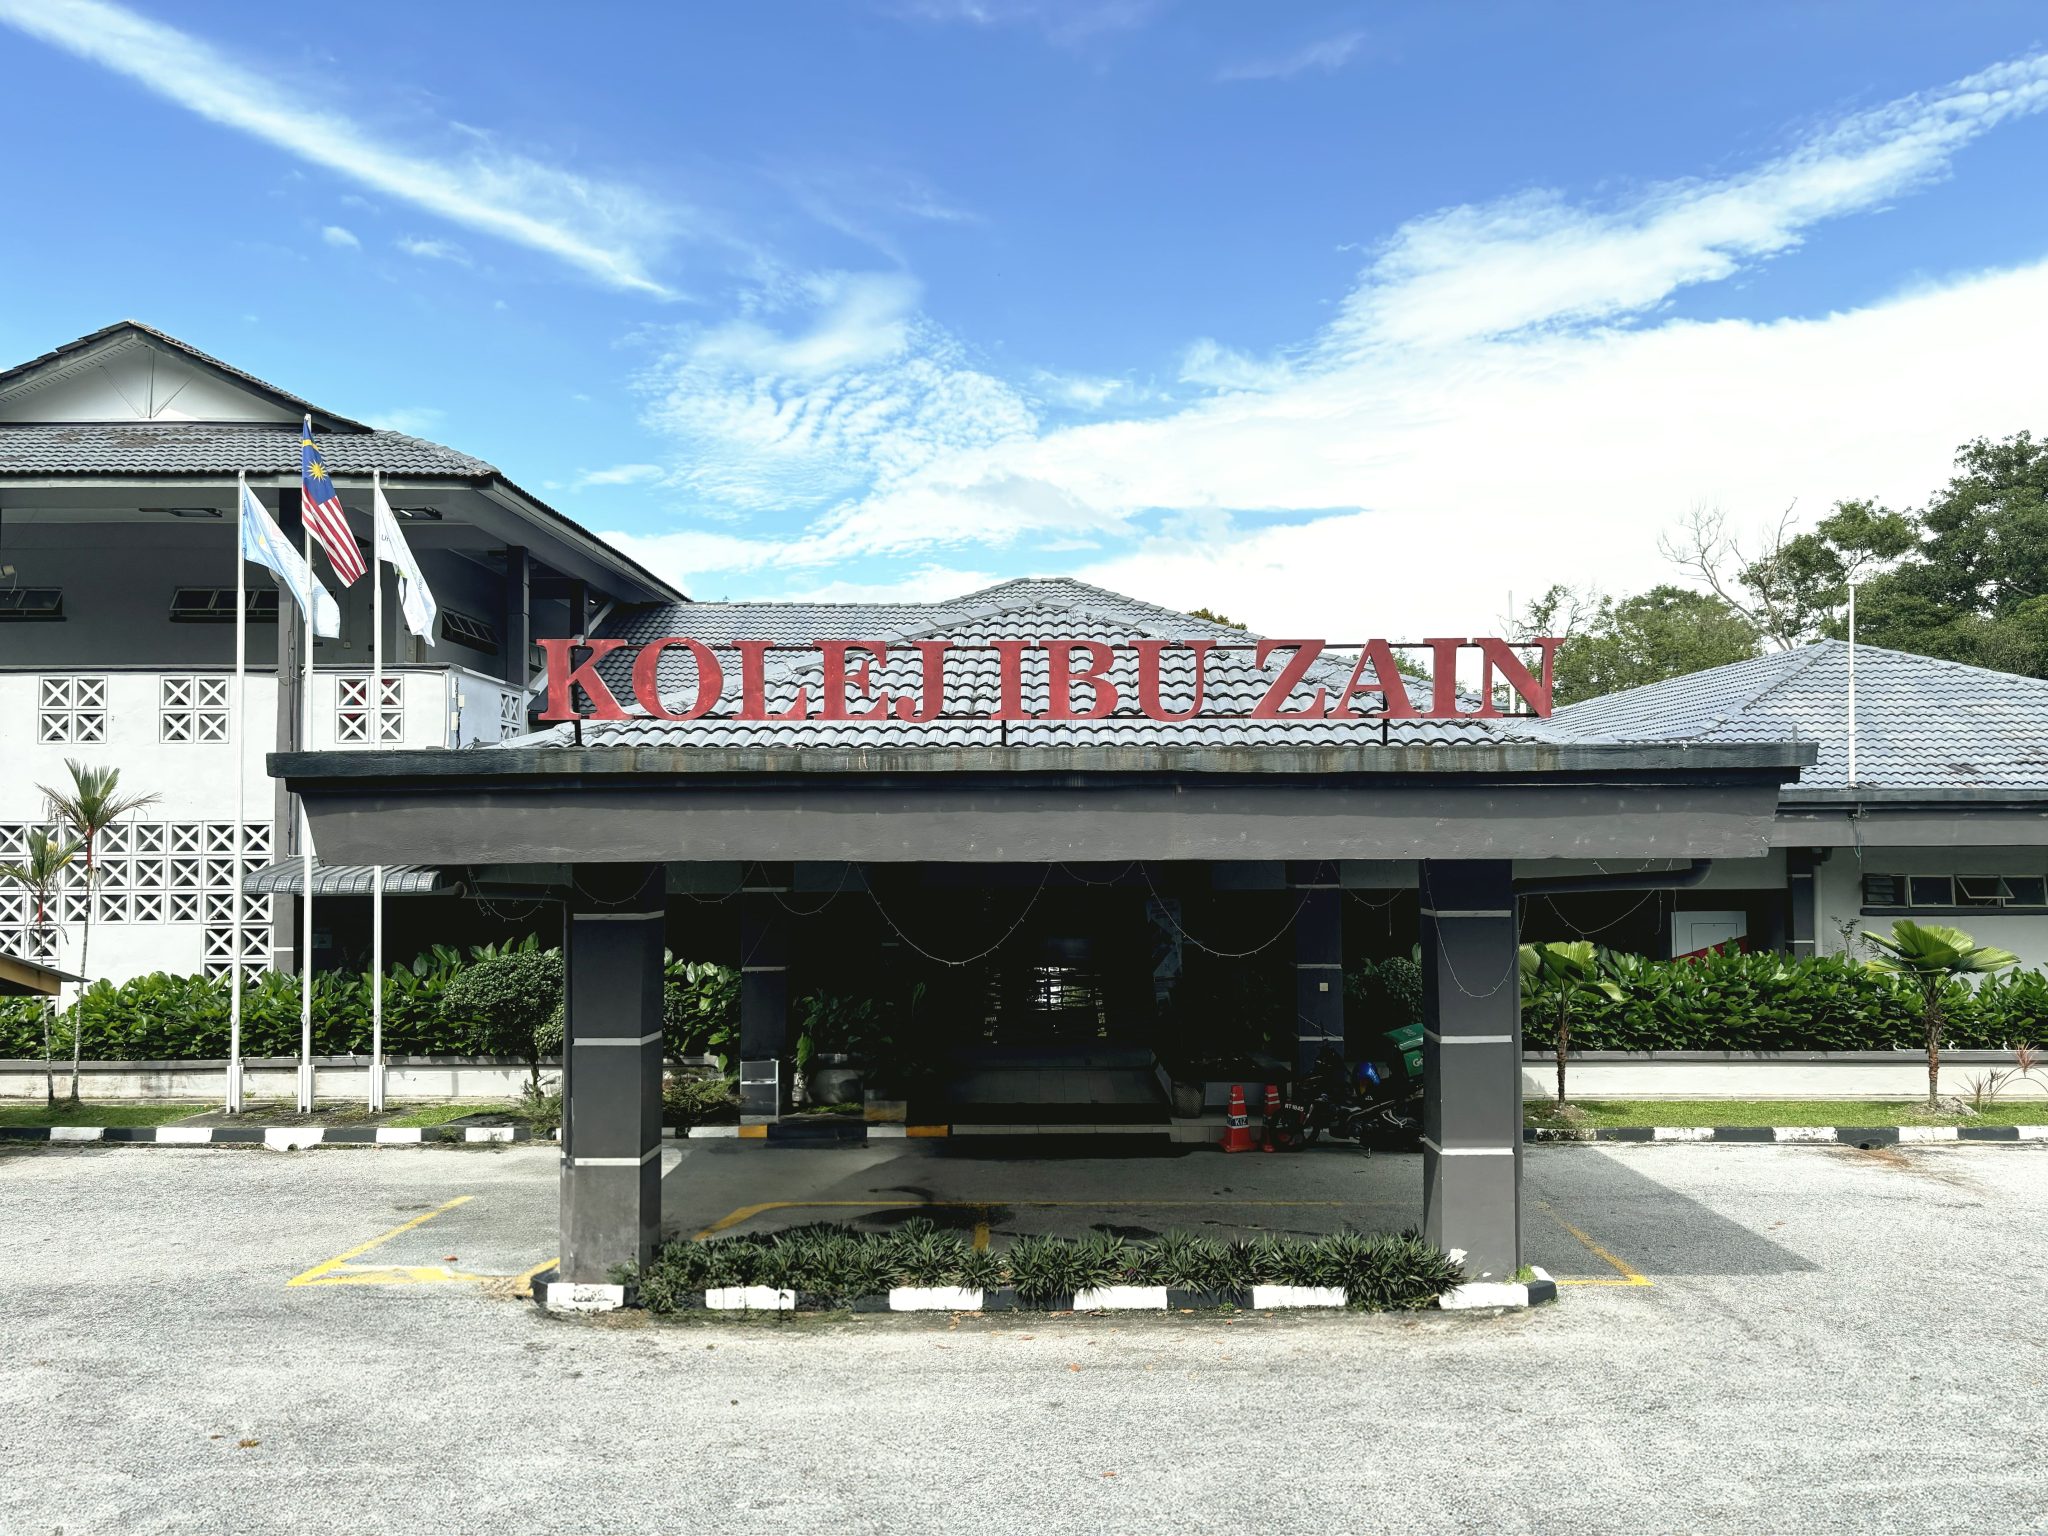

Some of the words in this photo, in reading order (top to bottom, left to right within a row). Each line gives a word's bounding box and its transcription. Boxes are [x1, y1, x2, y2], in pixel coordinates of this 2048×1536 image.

[536, 638, 954, 723] KOLEJ
[988, 639, 1217, 722] IBU
[1251, 637, 1565, 719] ZAIN
